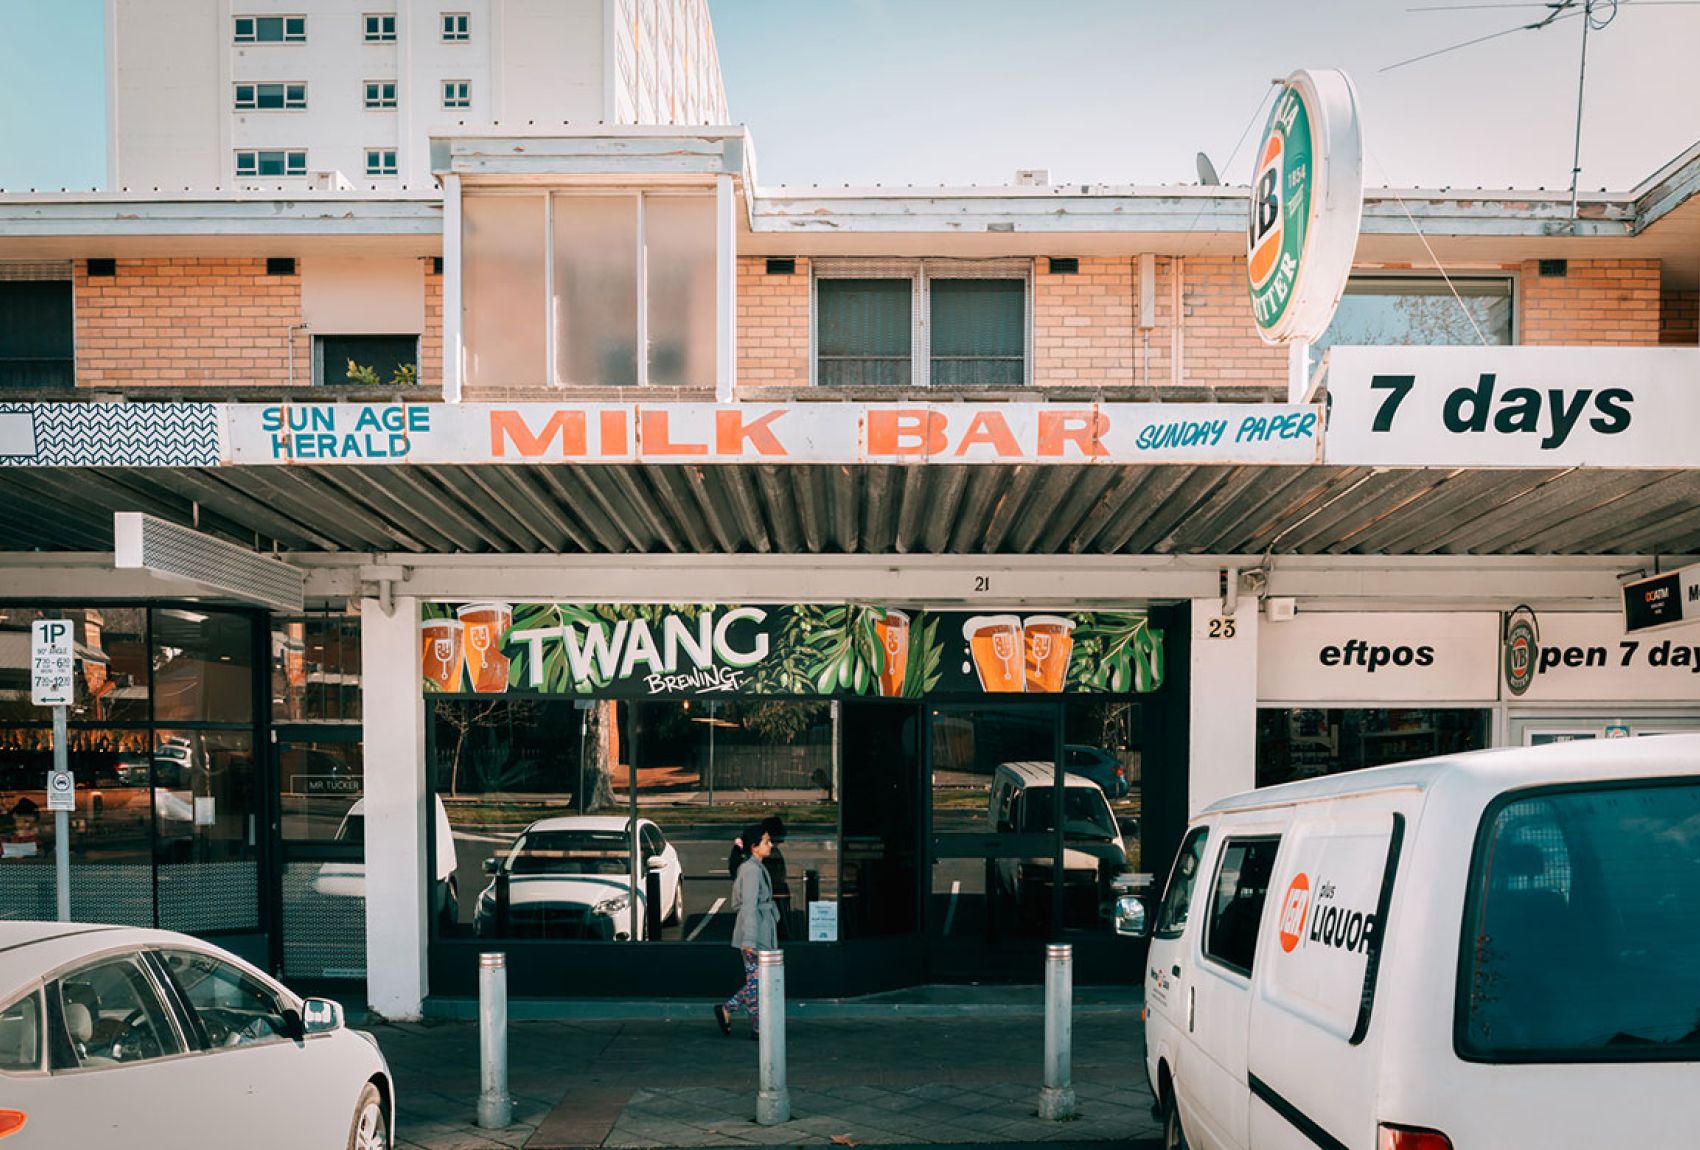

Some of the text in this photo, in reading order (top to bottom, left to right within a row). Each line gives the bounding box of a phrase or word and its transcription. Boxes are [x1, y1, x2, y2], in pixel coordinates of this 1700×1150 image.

[261, 406, 431, 432] SUN AGE
[1370, 375, 1416, 432] 7
[1443, 373, 1634, 450] days
[271, 433, 412, 458] HERALD
[490, 409, 1111, 457] MILK BAR
[1135, 412, 1317, 450] SUNDAY PAPER
[974, 575, 989, 591] 21
[39, 624, 66, 644] 1P
[1209, 619, 1236, 638] 23
[510, 607, 769, 688] TWANG
[1319, 639, 1435, 673] eftpos
[1536, 645, 1608, 674] pen
[1619, 641, 1639, 666] 7
